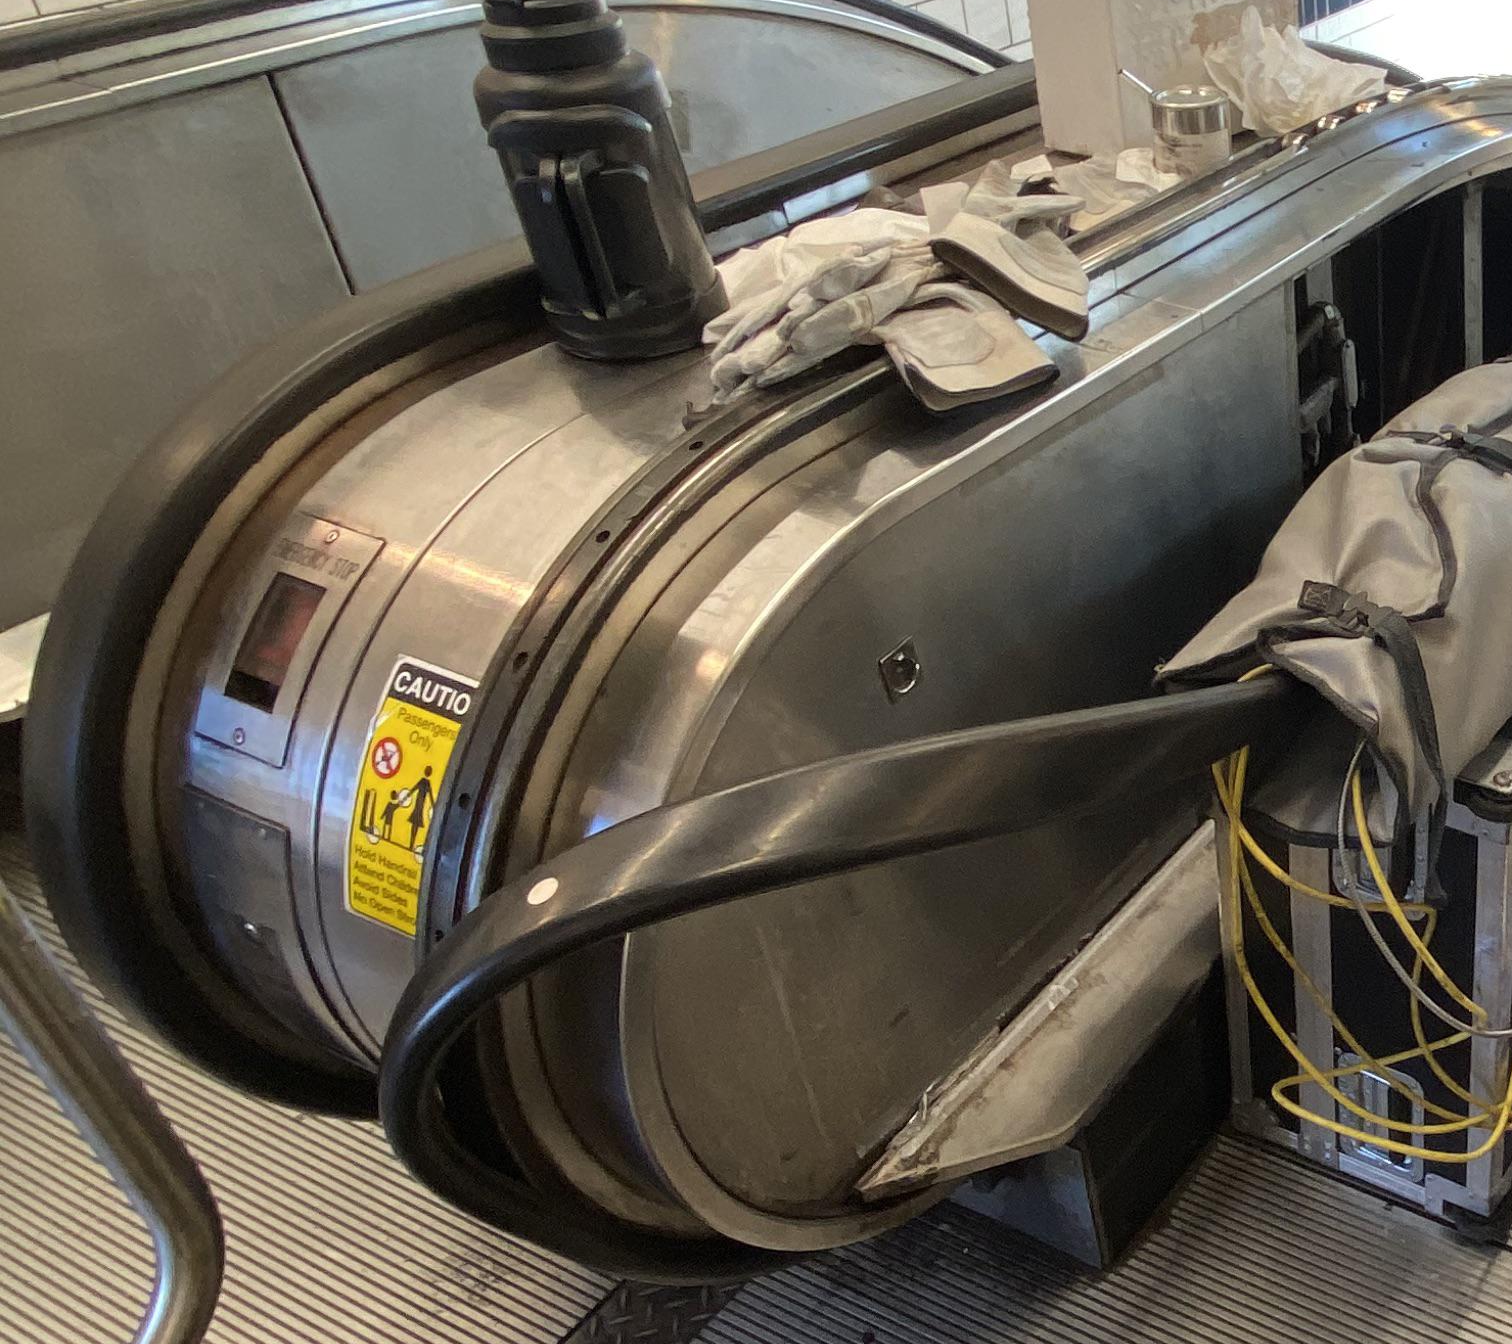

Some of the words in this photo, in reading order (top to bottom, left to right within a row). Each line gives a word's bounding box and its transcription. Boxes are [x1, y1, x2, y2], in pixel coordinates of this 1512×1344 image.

[393, 671, 472, 716] CAUTIO
[409, 730, 434, 752] Only
[354, 844, 376, 863] Hold
